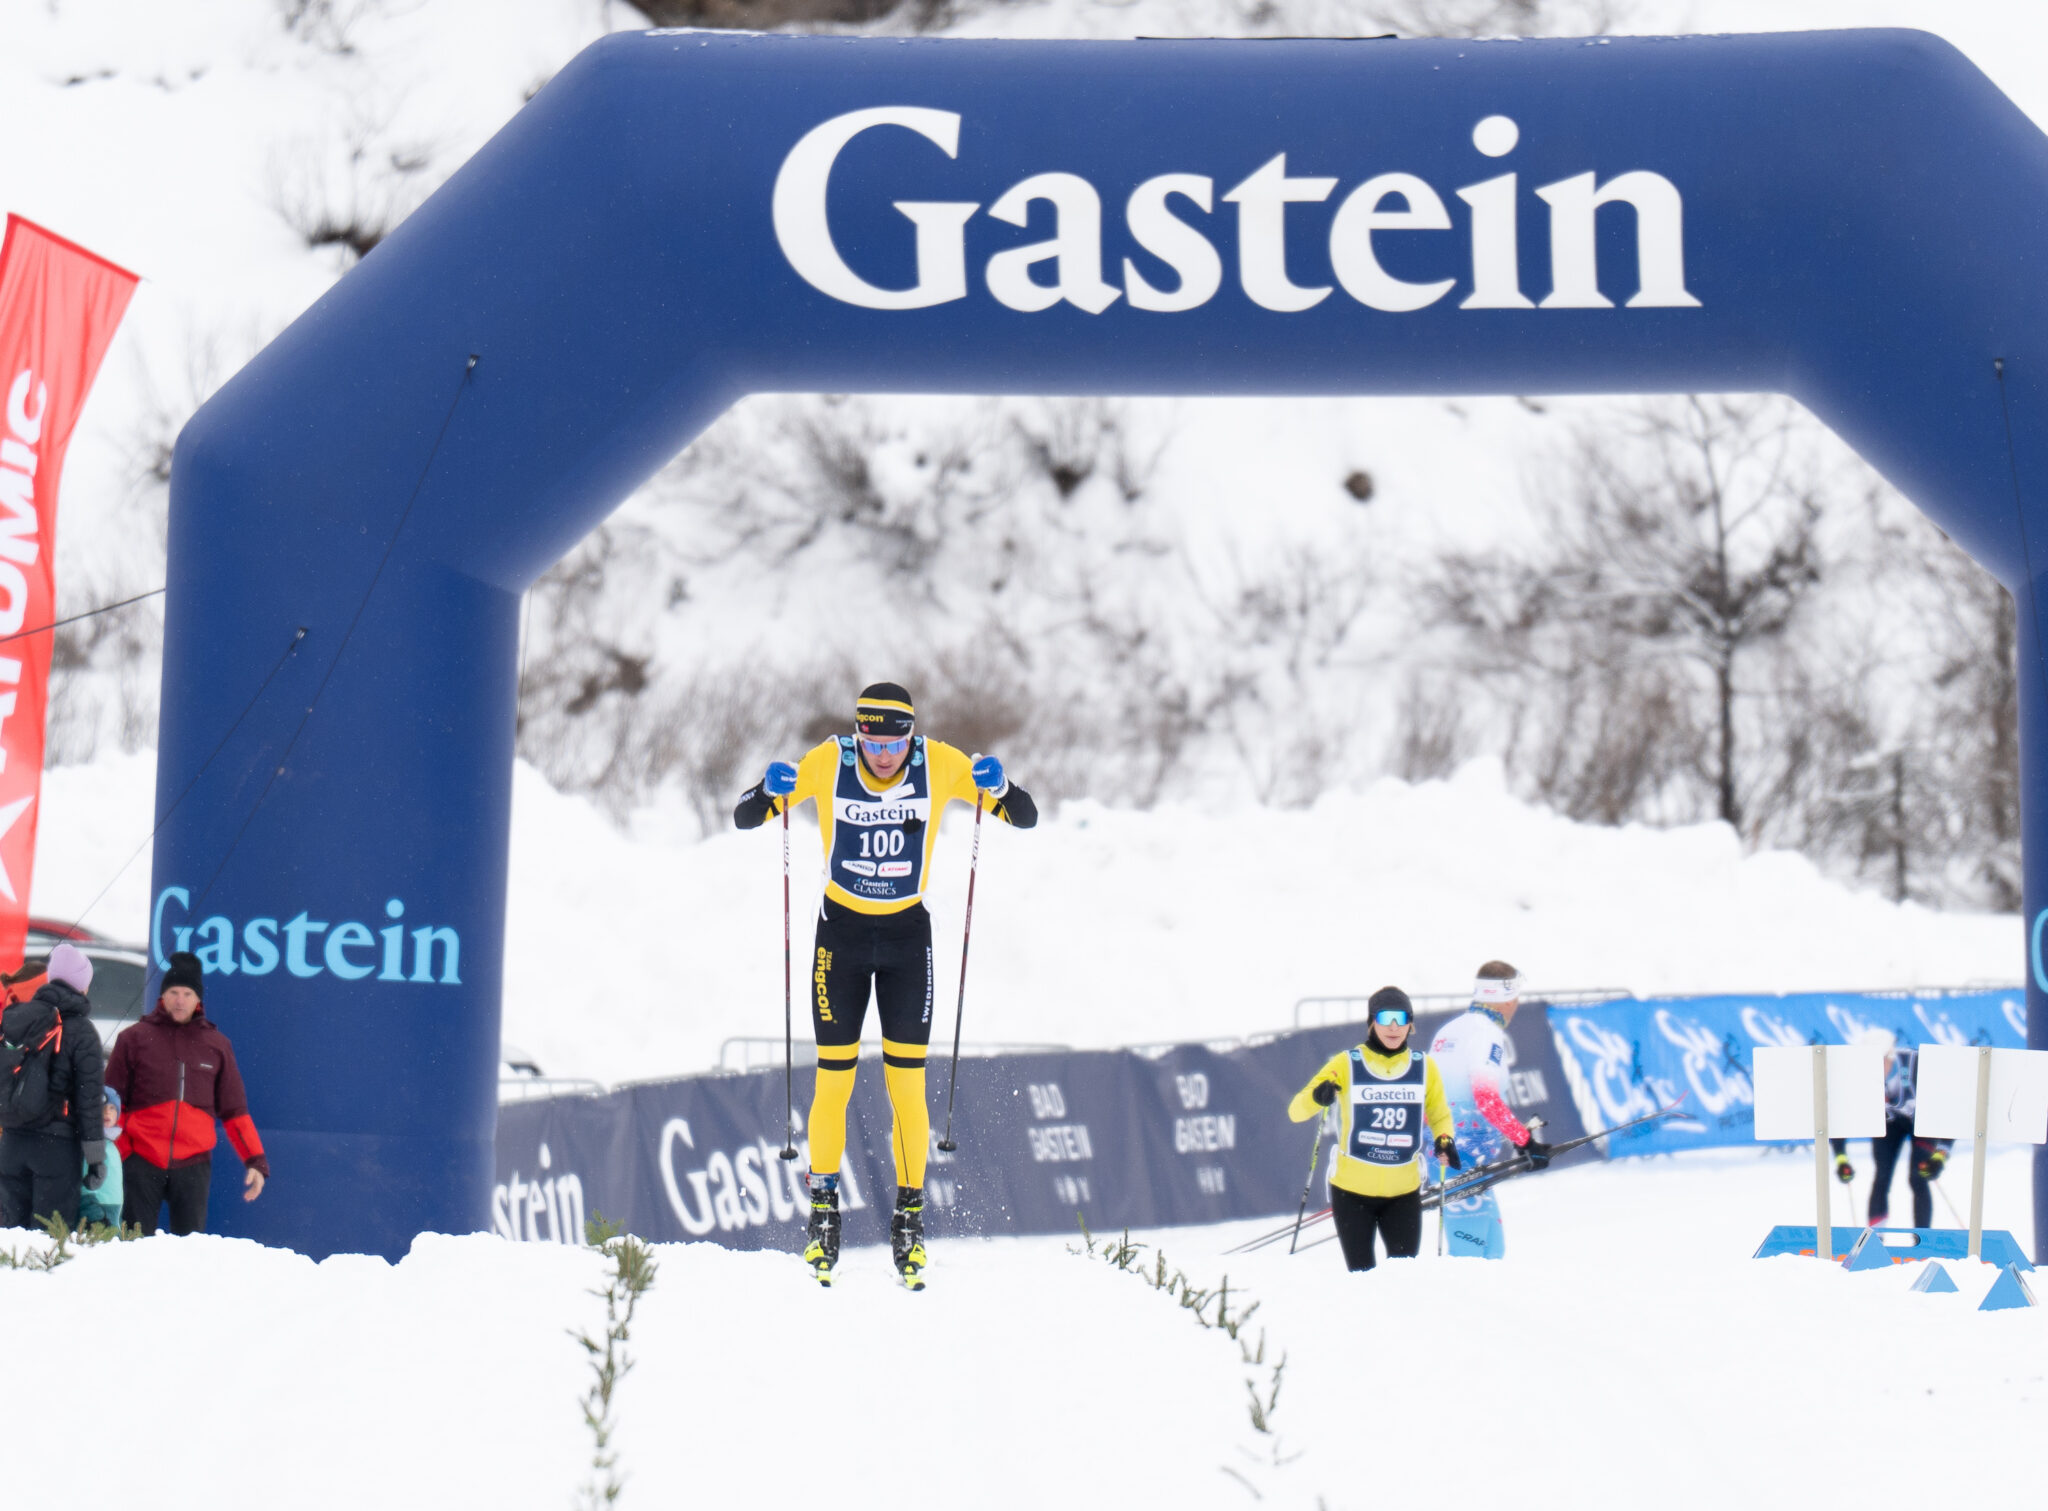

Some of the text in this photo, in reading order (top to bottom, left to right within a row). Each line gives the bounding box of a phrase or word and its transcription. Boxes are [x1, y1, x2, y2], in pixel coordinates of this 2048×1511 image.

[771, 105, 1703, 315] Gastein
[845, 803, 917, 823] Gastein
[859, 829, 905, 858] 100
[853, 882, 897, 896] CLASSICS
[152, 885, 464, 986] Gastein
[814, 946, 833, 1022] engcon
[921, 945, 933, 1024] SWEDEMOUNT
[1361, 1087, 1417, 1101] Gastein
[1371, 1107, 1408, 1130] 289
